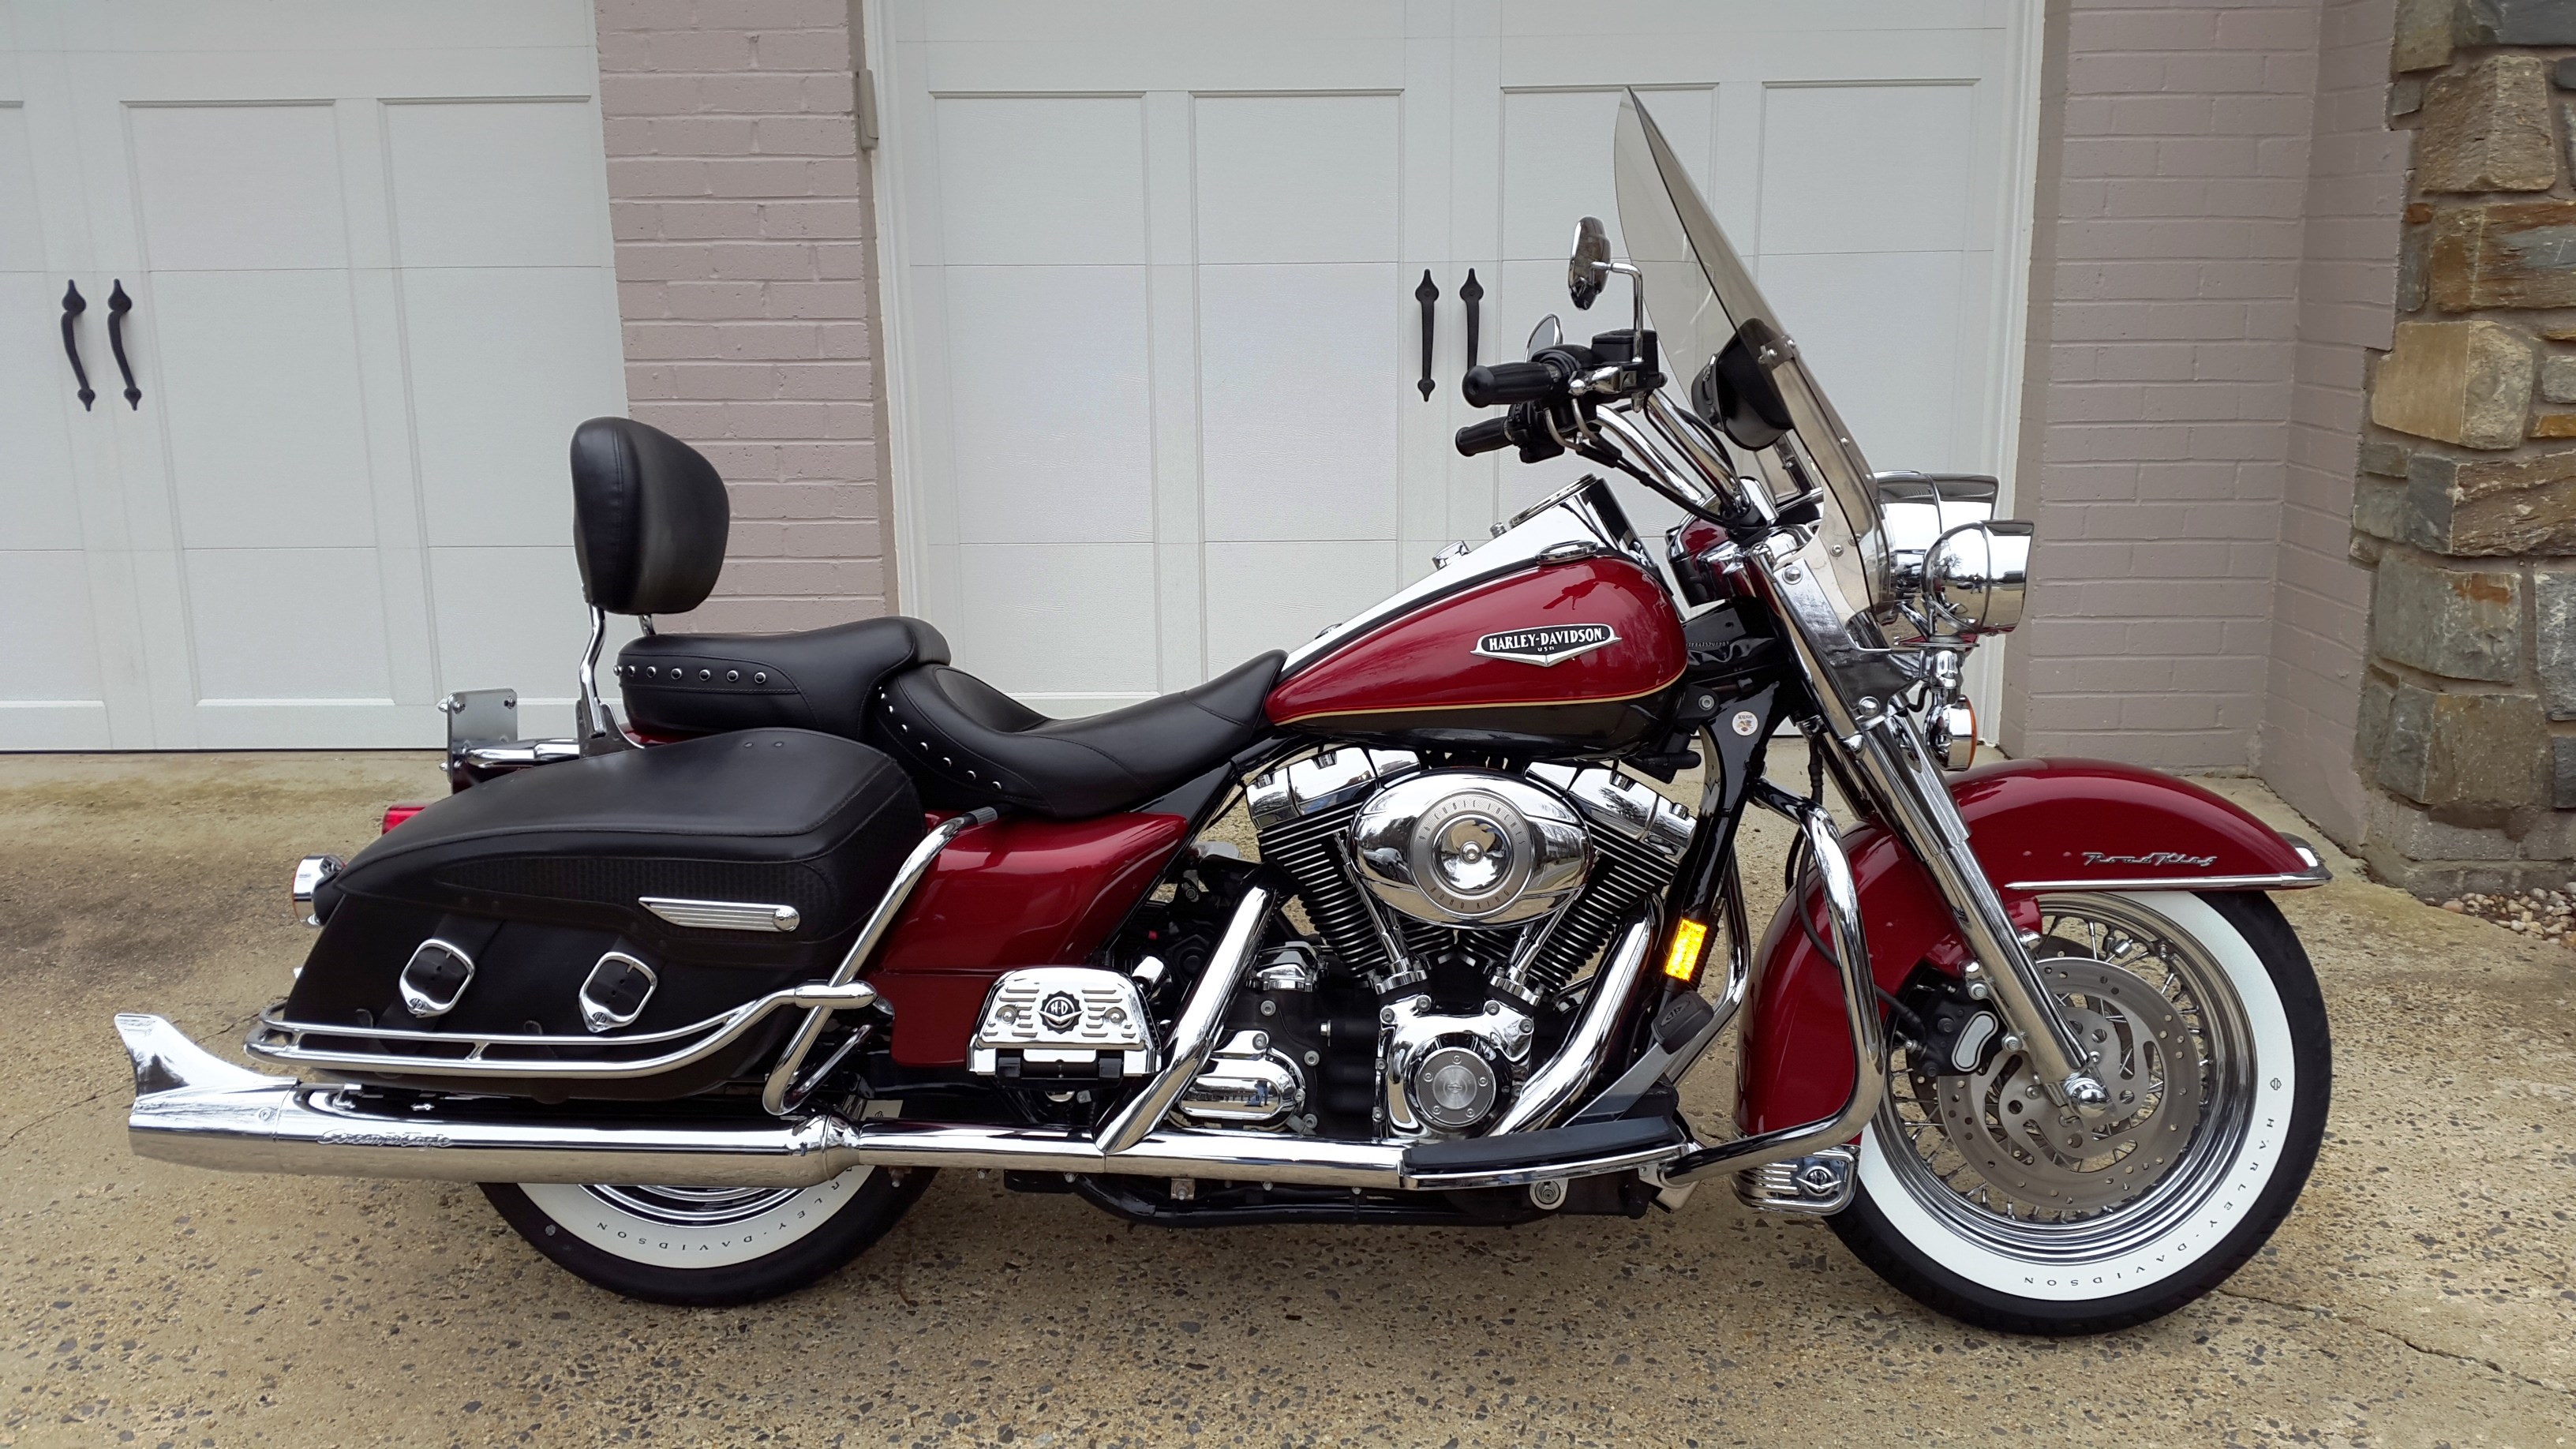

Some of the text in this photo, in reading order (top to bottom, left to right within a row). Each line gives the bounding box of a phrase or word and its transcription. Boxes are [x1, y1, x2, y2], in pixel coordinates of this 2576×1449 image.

[1434, 799, 1477, 820] CUBIC
[1487, 803, 1526, 844] INCHES
[1430, 887, 1511, 909] ROAD KING
